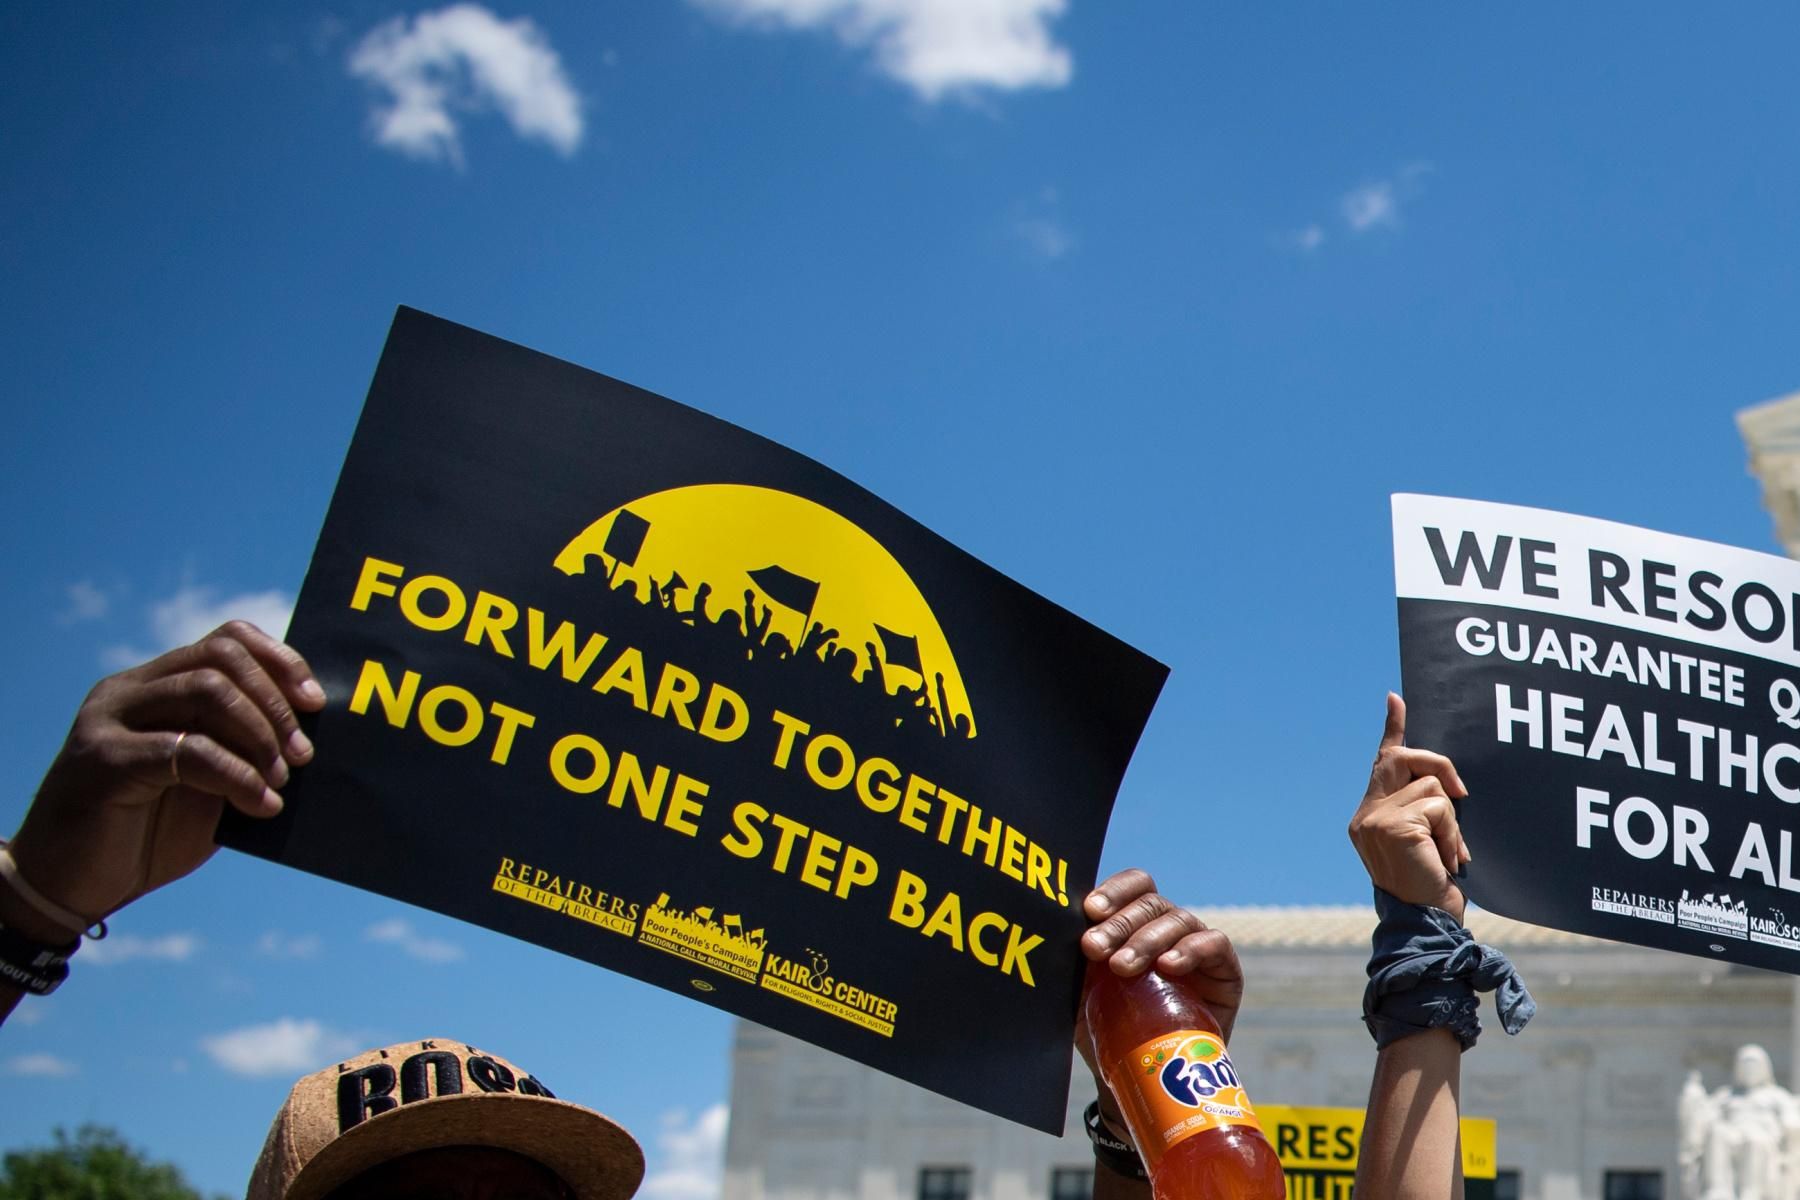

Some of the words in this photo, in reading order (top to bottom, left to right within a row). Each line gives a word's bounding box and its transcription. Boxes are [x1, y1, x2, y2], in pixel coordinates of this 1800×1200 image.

[1422, 525, 1560, 600] WE
[1455, 616, 1746, 708] GUARANTEE
[349, 556, 749, 743] FORWARD
[771, 709, 1069, 907] TOGETHER!
[350, 660, 535, 766] NOT
[549, 733, 710, 837] ONE
[720, 800, 879, 900] STEP
[888, 868, 1046, 988] BACK
[1576, 786, 1716, 875] FOR
[497, 878, 514, 893] OF
[523, 887, 556, 908] THE
[573, 904, 633, 934] BREACH
[499, 857, 640, 921] REPAIRERS
[1592, 886, 1675, 914] REPAIRERS
[1609, 903, 1628, 914] THE
[1638, 908, 1673, 923] BREACH
[646, 918, 669, 935] Poor
[670, 927, 711, 951] People's
[711, 943, 759, 969] Campaign
[646, 934, 679, 953] NATIONAL
[680, 945, 698, 960] CALL
[707, 955, 731, 973] MORAL
[730, 964, 758, 982] REVIVAL
[764, 978, 778, 990] FOR
[815, 995, 839, 1013] RIGHTS
[845, 1008, 867, 1025] SOCIAL
[835, 982, 899, 1023] CENTER
